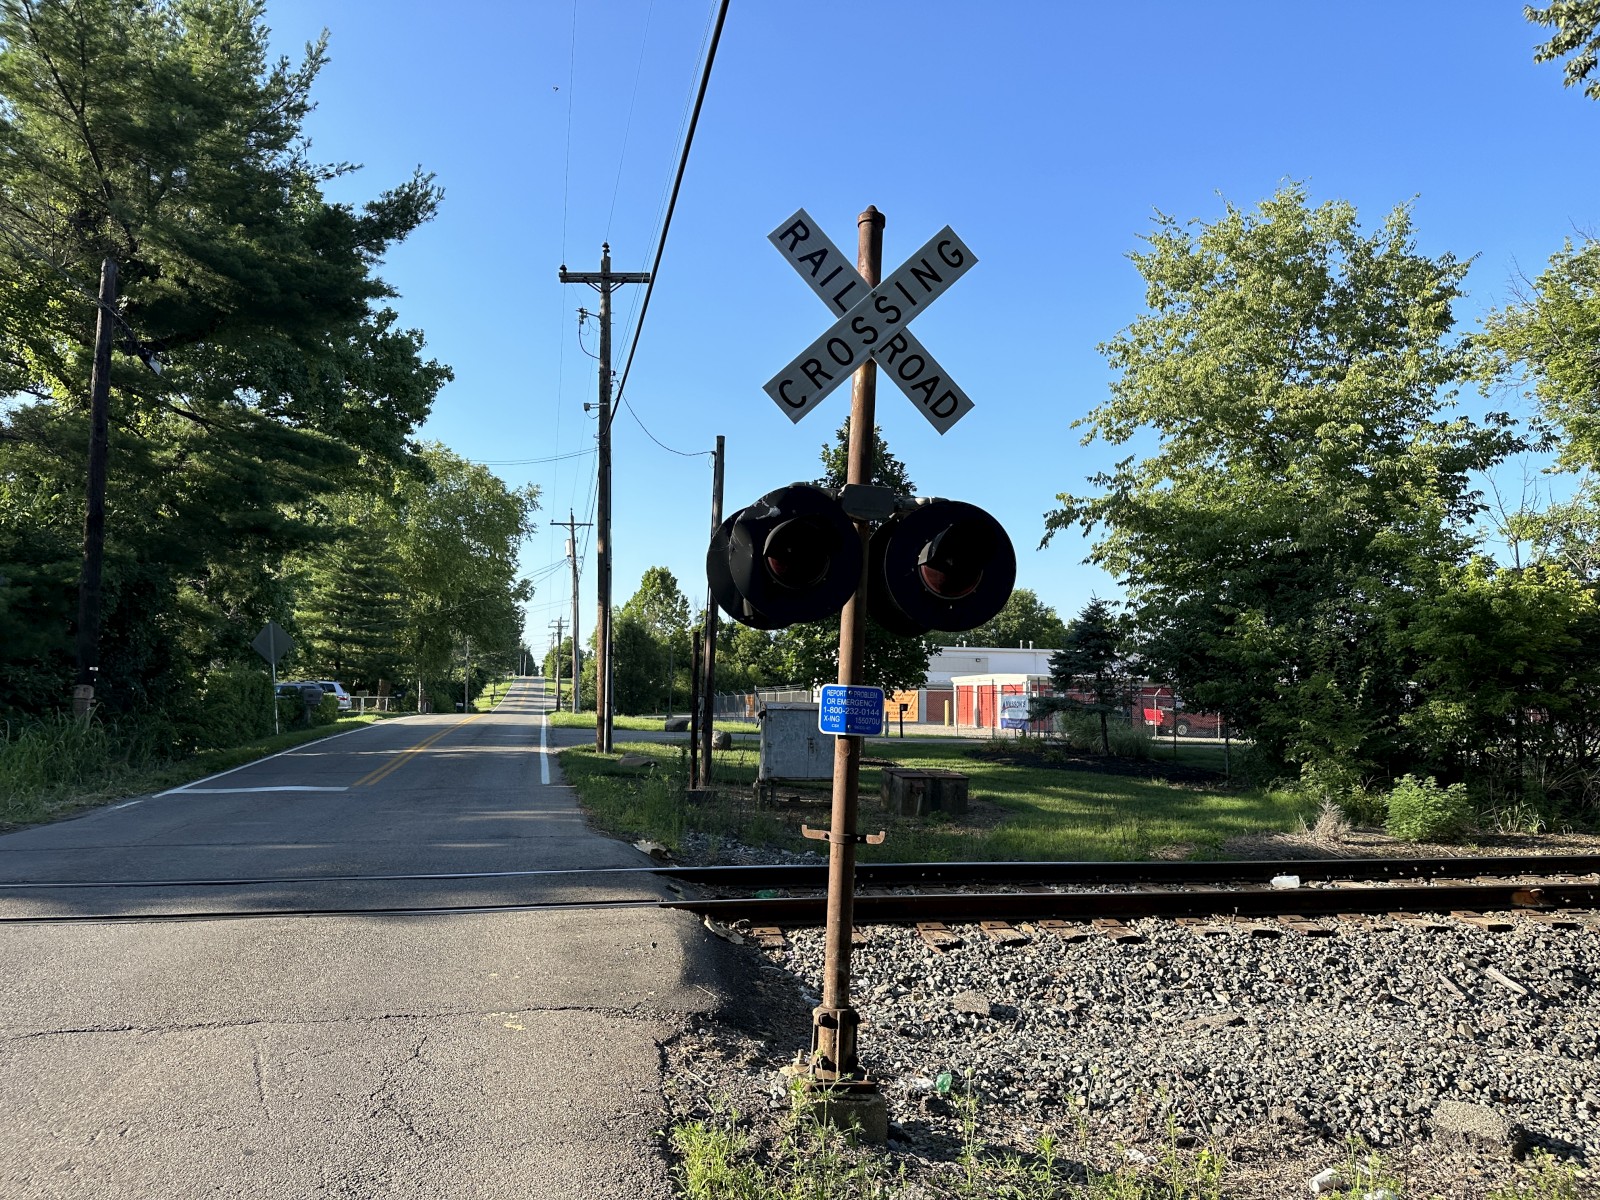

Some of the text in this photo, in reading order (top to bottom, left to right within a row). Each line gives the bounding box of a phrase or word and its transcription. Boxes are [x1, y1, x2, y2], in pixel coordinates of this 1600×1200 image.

[778, 219, 857, 313] RAIL
[778, 239, 964, 409] CROSSING
[878, 332, 959, 419] ROAD
[826, 689, 878, 699] REPORT PROBLEM
[826, 697, 877, 707] OR EMERGENCY
[823, 706, 880, 716] 1-800-232-0144
[823, 715, 841, 723] X-ING
